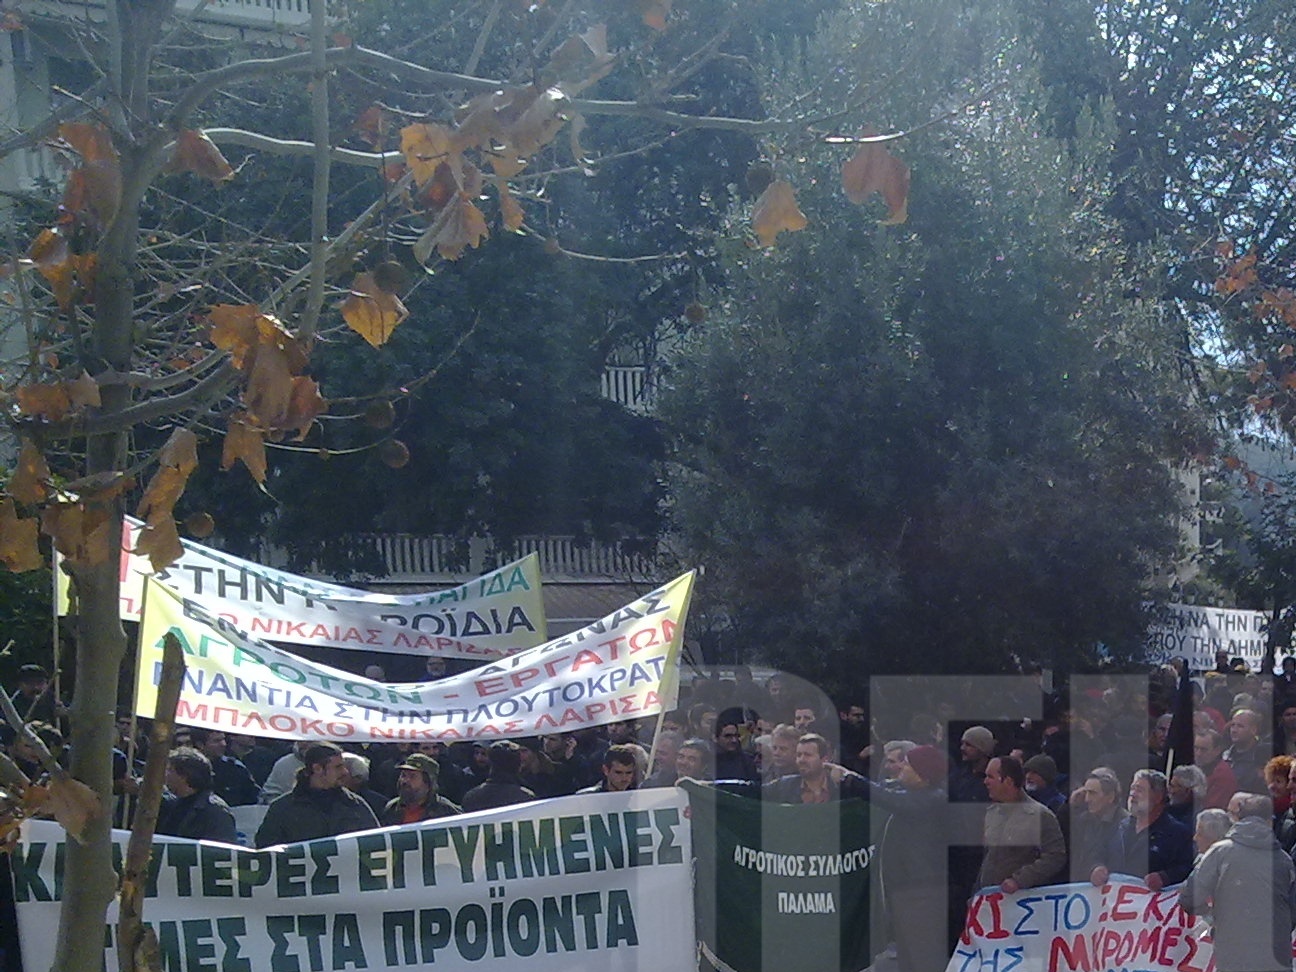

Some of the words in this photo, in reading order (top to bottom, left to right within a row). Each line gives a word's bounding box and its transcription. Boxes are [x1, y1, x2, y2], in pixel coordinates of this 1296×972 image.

[1216, 613, 1248, 633] ΤΗΝ
[13, 838, 340, 901] ΚΥΤΕΡΕΣ
[358, 807, 684, 893] ΕΓΓΥΗΜΕΝΕΣ
[734, 844, 805, 877] ΑΓΡΟΤΙΚΟΣ
[777, 892, 836, 914] ΠΑΛΑΜΑ
[1013, 894, 1090, 936] ΣΤΟ
[383, 887, 640, 968] ΠΡΟΪΟΝΤΑ
